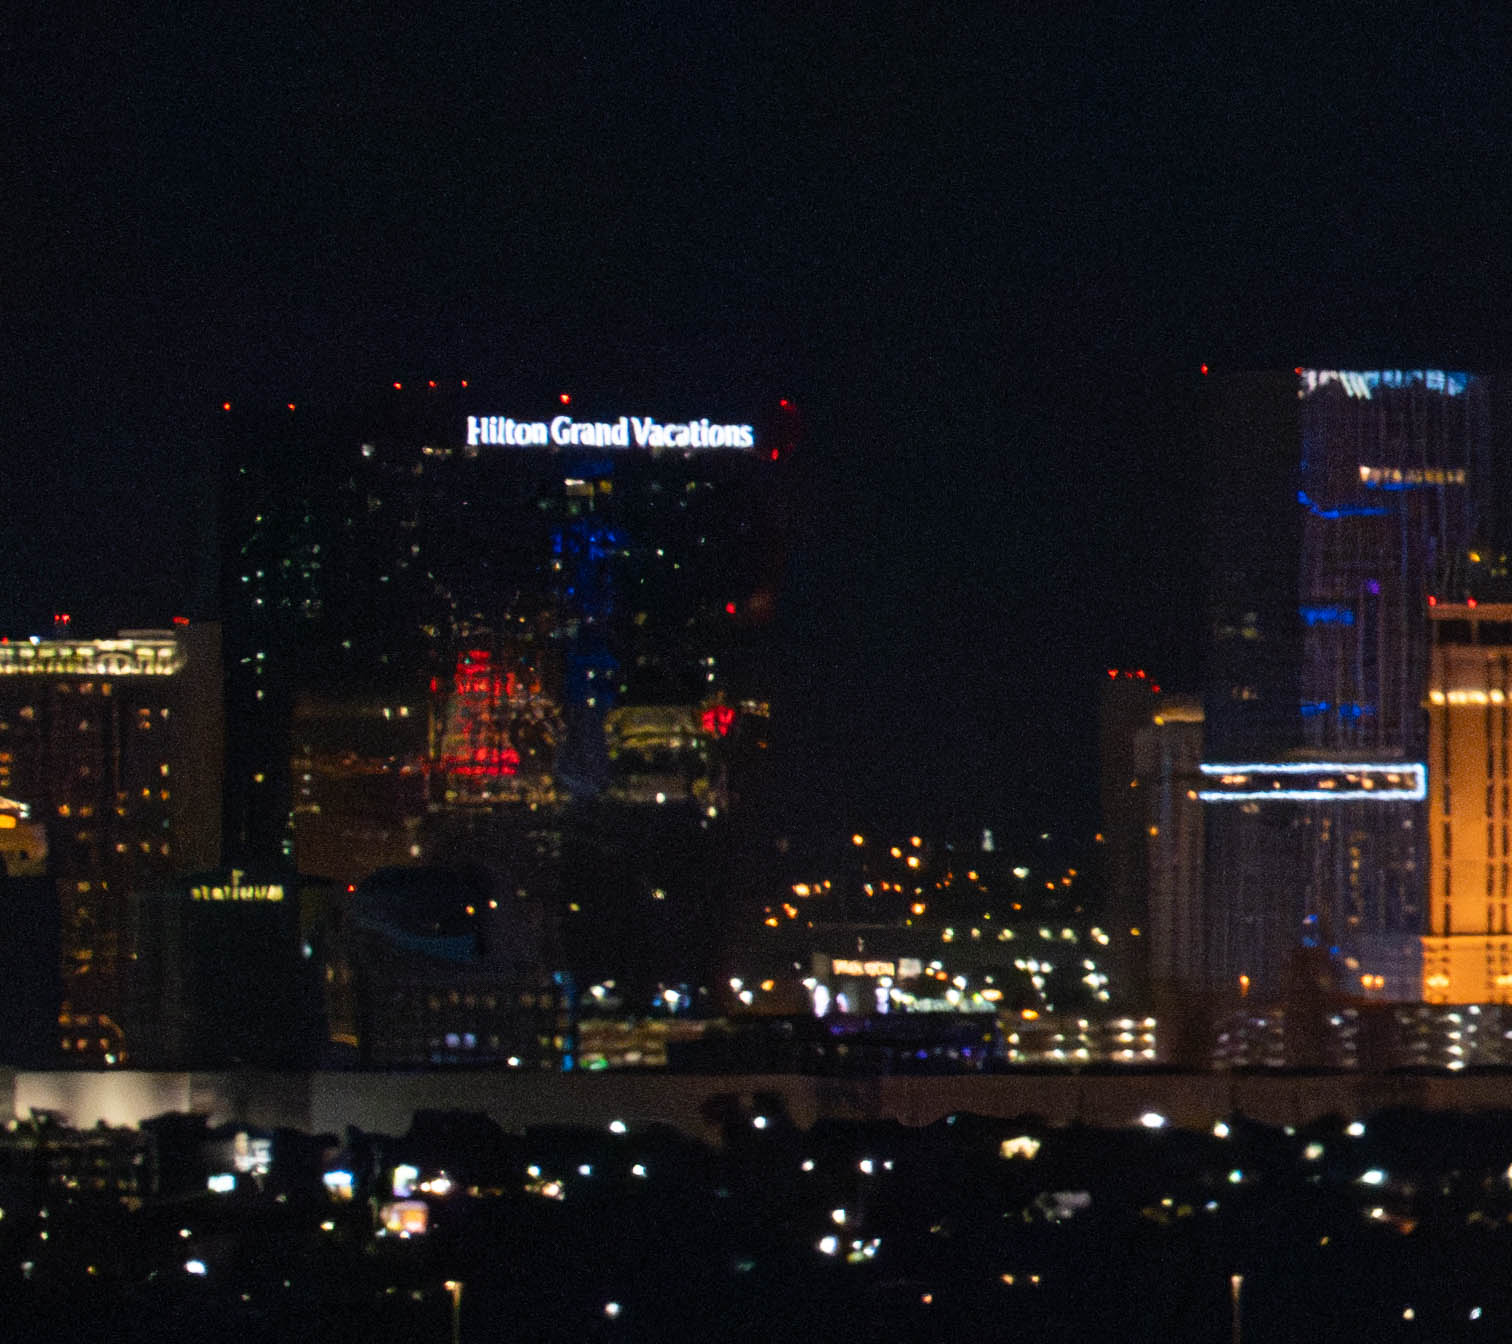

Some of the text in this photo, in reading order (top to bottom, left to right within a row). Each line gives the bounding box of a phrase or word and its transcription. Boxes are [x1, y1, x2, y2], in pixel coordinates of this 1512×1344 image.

[466, 415, 754, 448] Hilton Grand Vacations
